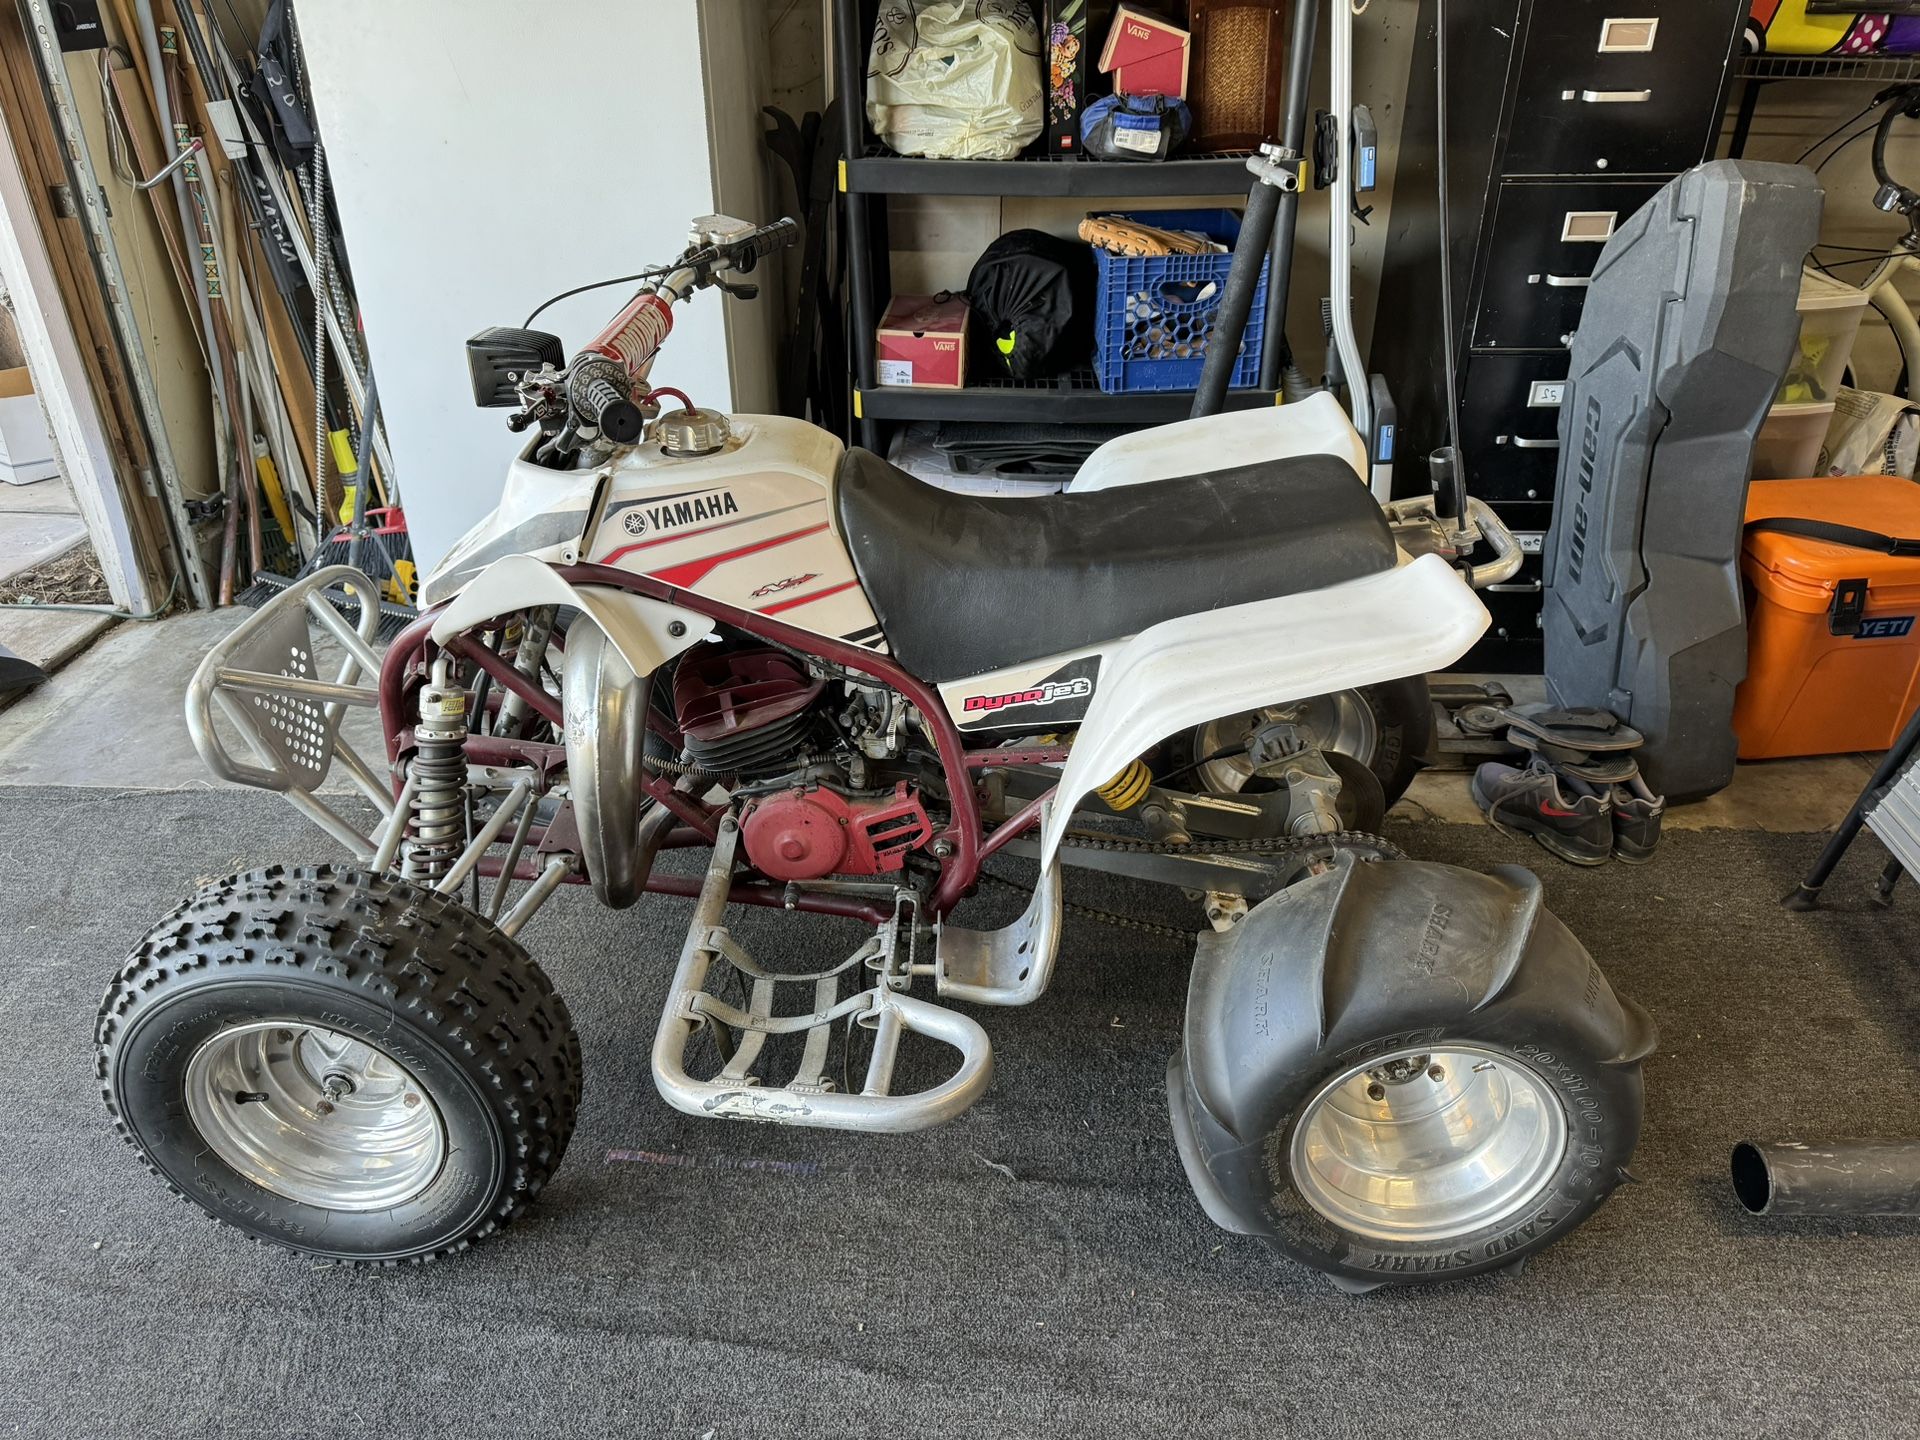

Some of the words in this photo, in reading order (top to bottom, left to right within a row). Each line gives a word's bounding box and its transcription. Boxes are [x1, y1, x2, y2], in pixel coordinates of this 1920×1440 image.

[1127, 22, 1152, 40] VANS
[933, 341, 956, 351] VANS
[646, 491, 739, 531] YAMAHA
[1861, 620, 1910, 636] YETI
[963, 680, 1089, 711] Dynojet
[1483, 1208, 1558, 1259] SAND
[1367, 1248, 1471, 1271] SHARK
